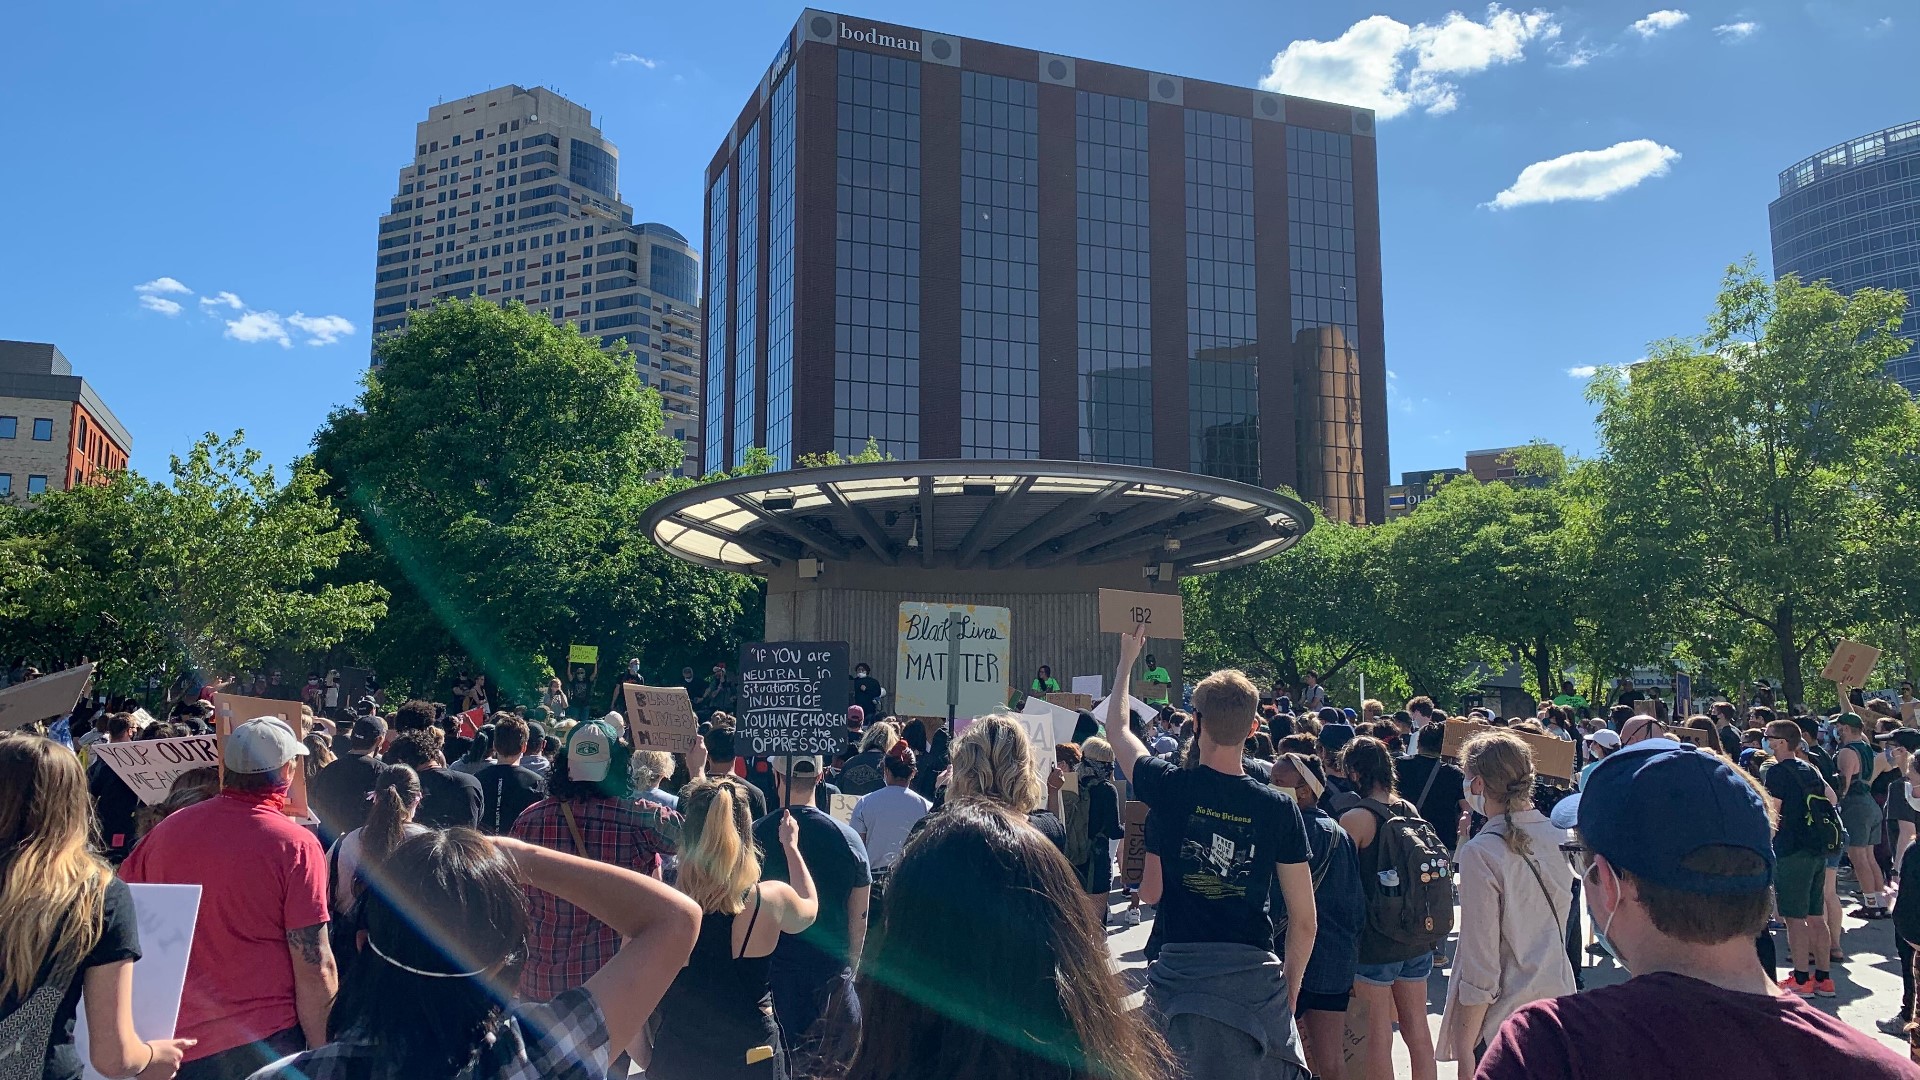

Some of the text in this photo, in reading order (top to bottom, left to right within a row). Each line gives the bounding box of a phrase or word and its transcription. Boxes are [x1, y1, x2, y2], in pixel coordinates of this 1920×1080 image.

[840, 22, 920, 52] bodman
[1130, 607, 1151, 624] 1B2
[905, 614, 1005, 641] Black Lives
[772, 647, 801, 664] YOU
[807, 651, 831, 662] are
[743, 666, 831, 681] NEUTRAL in
[905, 652, 999, 683] MATTER
[742, 683, 800, 699] Situations
[635, 691, 689, 711] BLACK
[749, 695, 821, 708] INJUSTICE
[637, 708, 692, 729] LIVES
[742, 712, 847, 728] YOU HAVE CHOSEN
[737, 728, 760, 738] THE
[763, 728, 788, 737] SIDE
[812, 727, 832, 738] the
[752, 736, 845, 754] OPPRESSOR."
[98, 745, 152, 768] YOUR
[1196, 805, 1252, 823] No New Prisons
